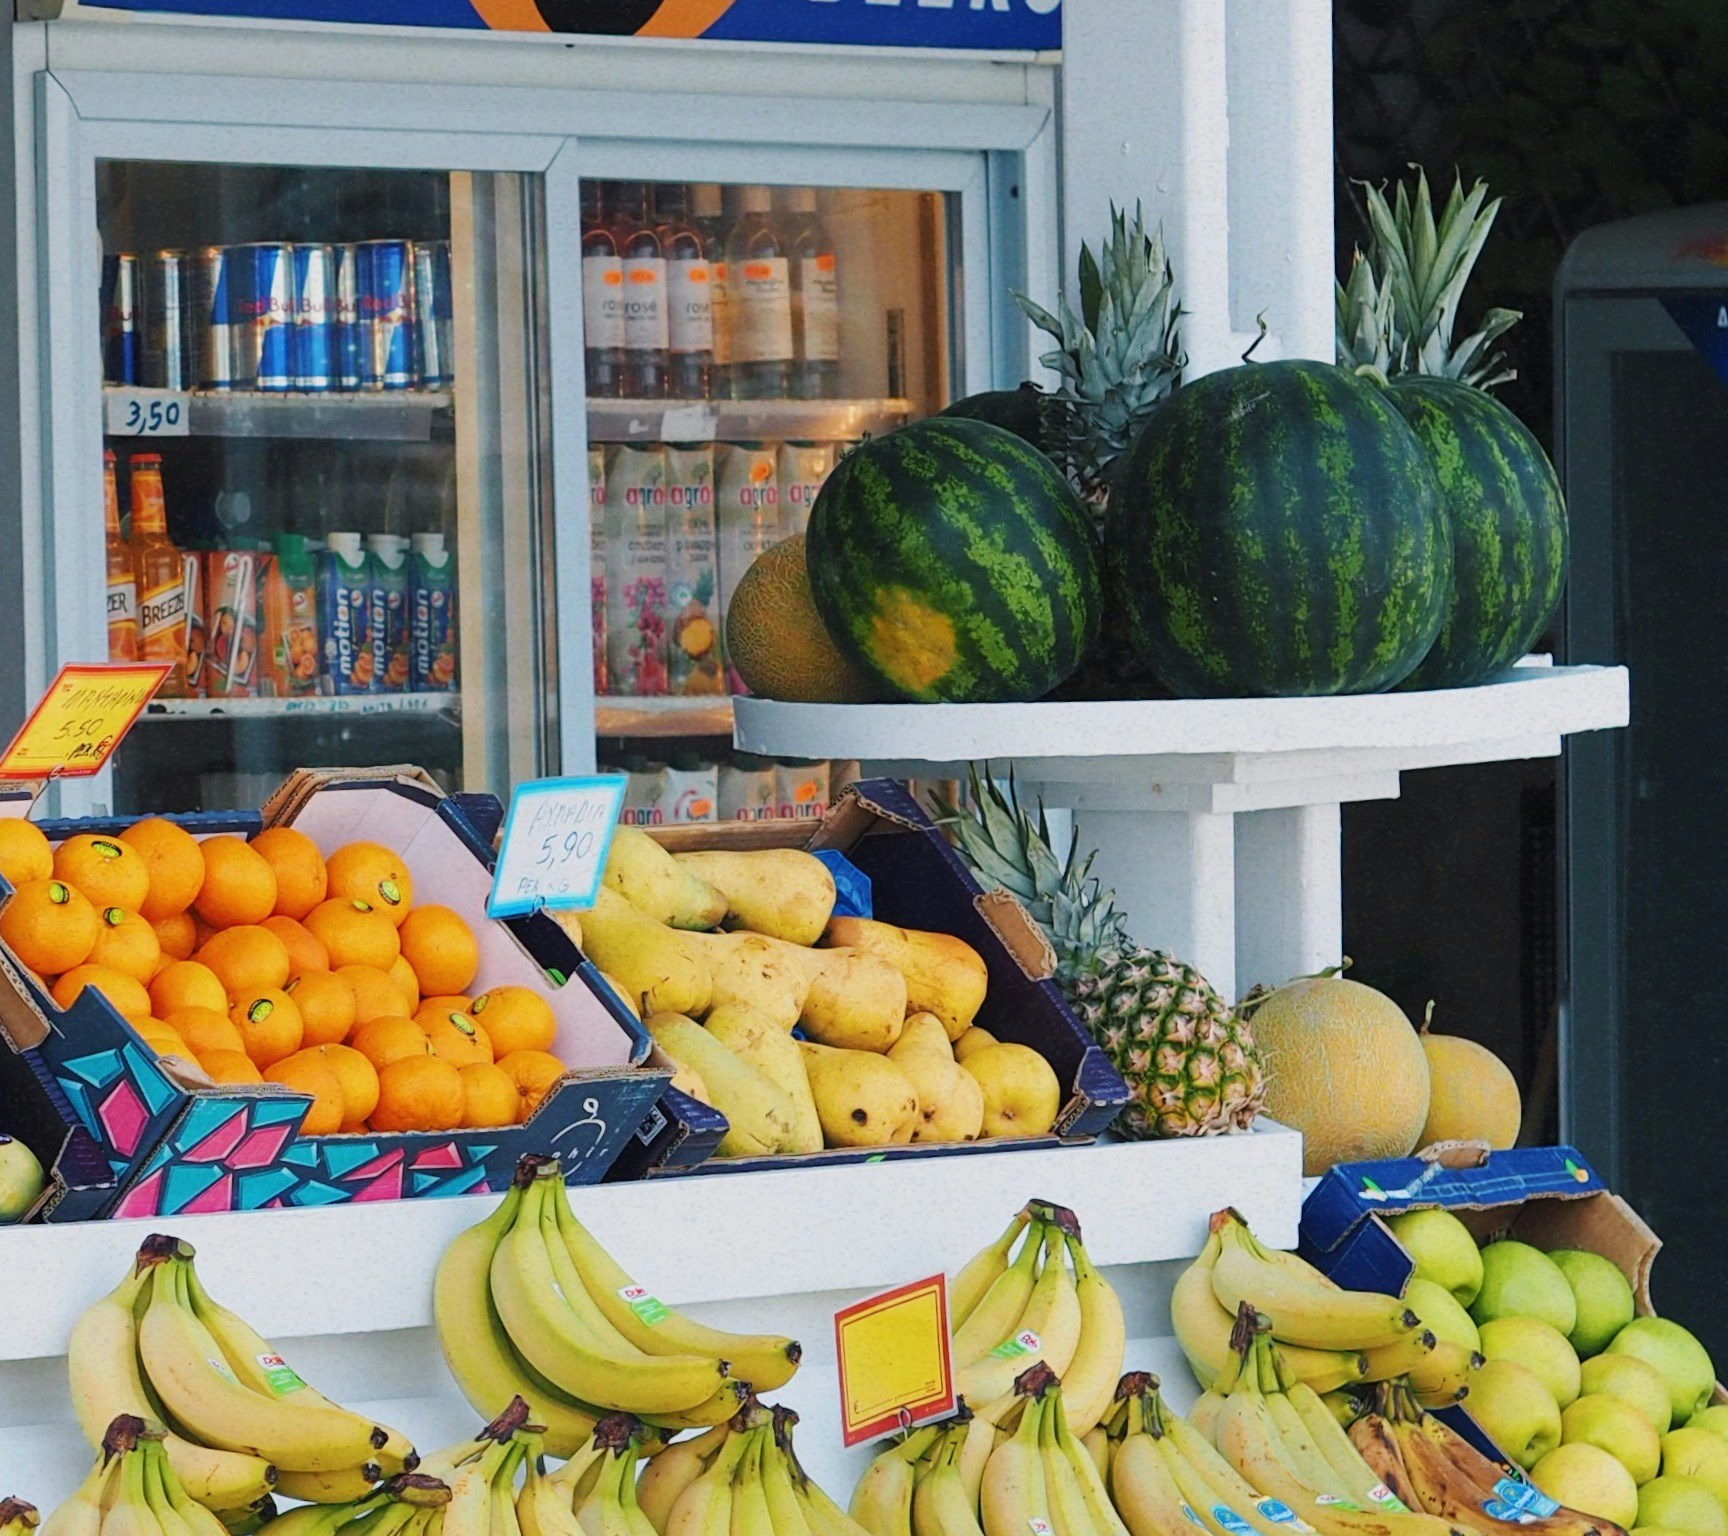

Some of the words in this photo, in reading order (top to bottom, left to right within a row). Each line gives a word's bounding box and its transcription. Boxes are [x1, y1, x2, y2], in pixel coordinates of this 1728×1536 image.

[125, 400, 180, 434] 3,50
[626, 485, 667, 510] agro
[670, 484, 713, 511] agro
[739, 485, 778, 510] agro
[141, 591, 185, 629] BREEZE
[335, 588, 349, 675] motion
[372, 588, 385, 675] motion
[417, 588, 430, 675] motion
[537, 831, 593, 871] 5,90
[625, 1287, 646, 1298] Dole
